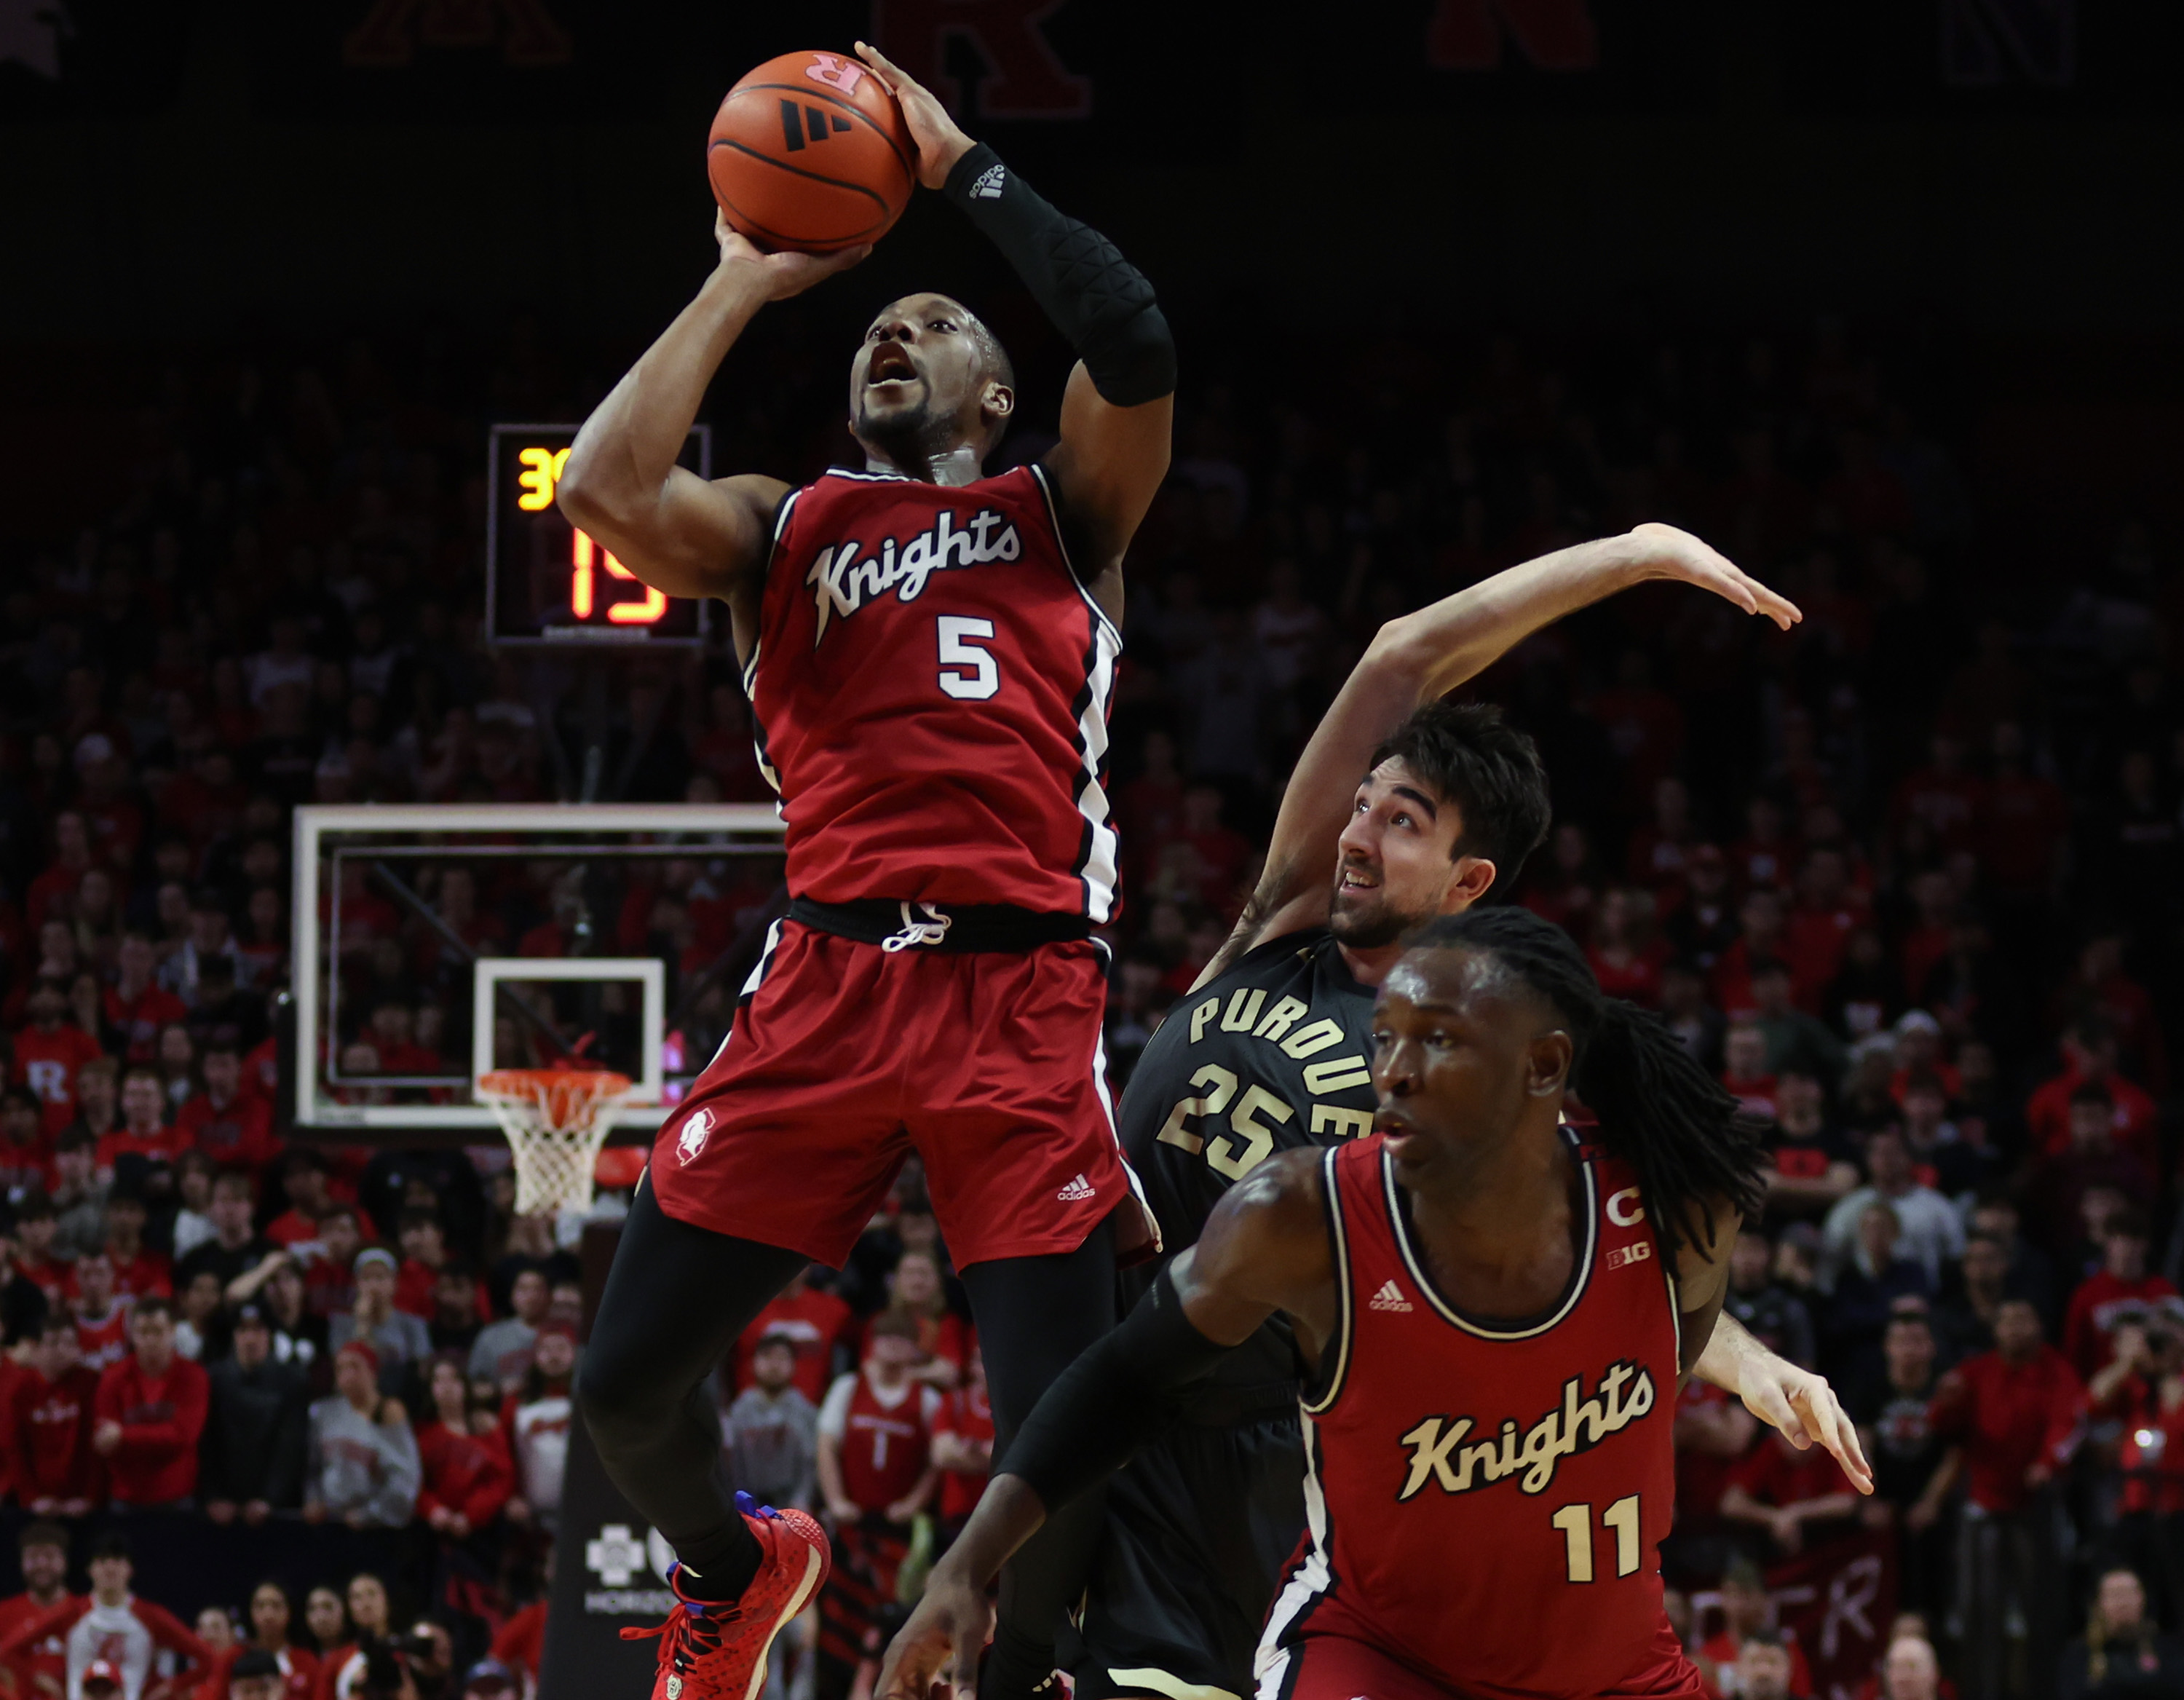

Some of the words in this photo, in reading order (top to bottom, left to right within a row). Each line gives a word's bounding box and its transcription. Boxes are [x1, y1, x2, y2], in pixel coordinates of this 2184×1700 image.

[805, 54, 866, 96] R
[968, 164, 1005, 199] adidas
[805, 510, 1021, 649] Knights
[937, 614, 1000, 700] 5
[1190, 987, 1374, 1138] PURDUE
[1155, 1063, 1296, 1182] 25
[1057, 1187, 1096, 1201] adidas
[1605, 1185, 1645, 1227] C
[1369, 1300, 1414, 1313] adidas
[1397, 1359, 1655, 1501] Knights
[1552, 1493, 1641, 1583] 11
[585, 1589, 681, 1616] HORIZO
